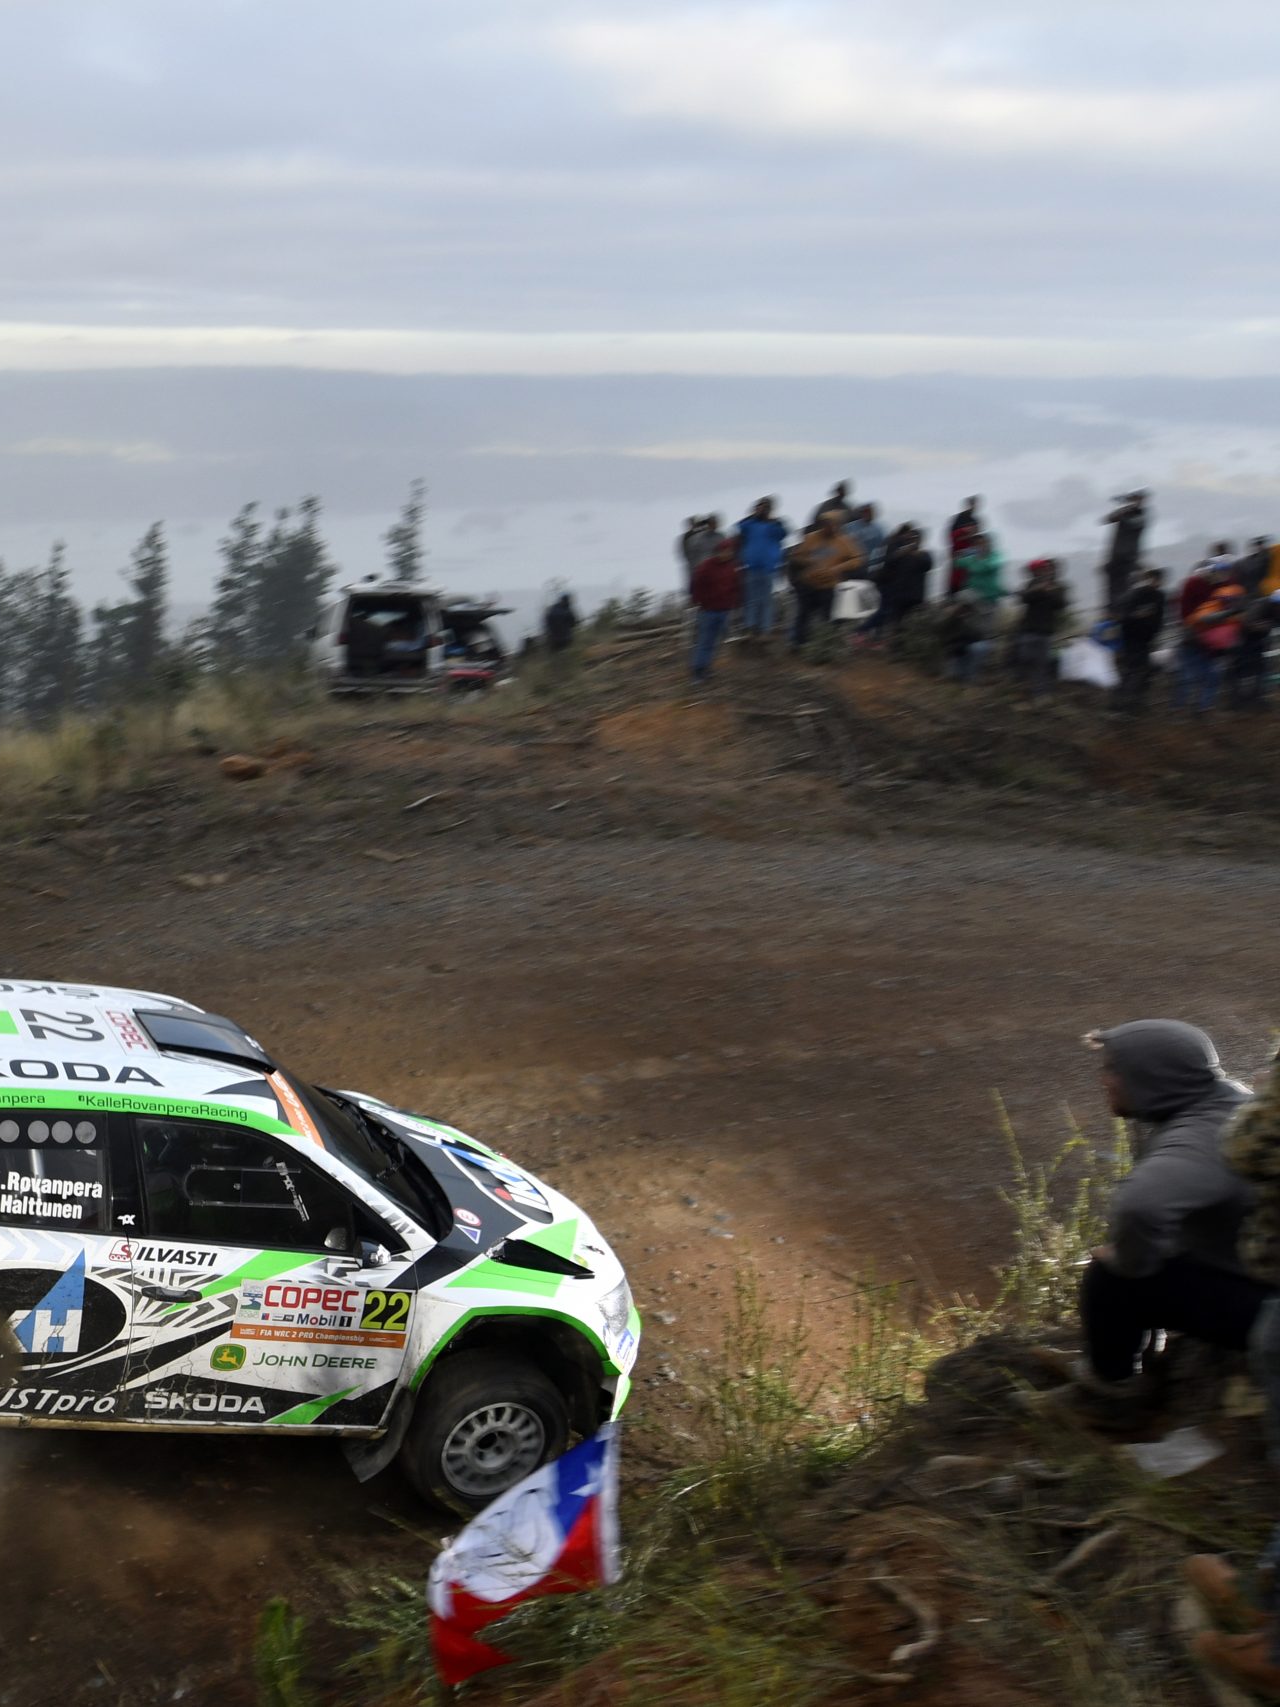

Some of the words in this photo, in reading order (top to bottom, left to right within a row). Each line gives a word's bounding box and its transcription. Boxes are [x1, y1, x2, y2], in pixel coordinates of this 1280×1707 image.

[19, 1008, 105, 1042] 22
[296, 1313, 338, 1327] Mobil
[360, 1290, 411, 1330] 22
[260, 1329, 273, 1337] FIA
[274, 1330, 290, 1338] WRC
[315, 1333, 365, 1343] Championship
[252, 1352, 308, 1367] JOHN
[312, 1354, 378, 1370] DEERE
[144, 1387, 267, 1415] ŠKODA
